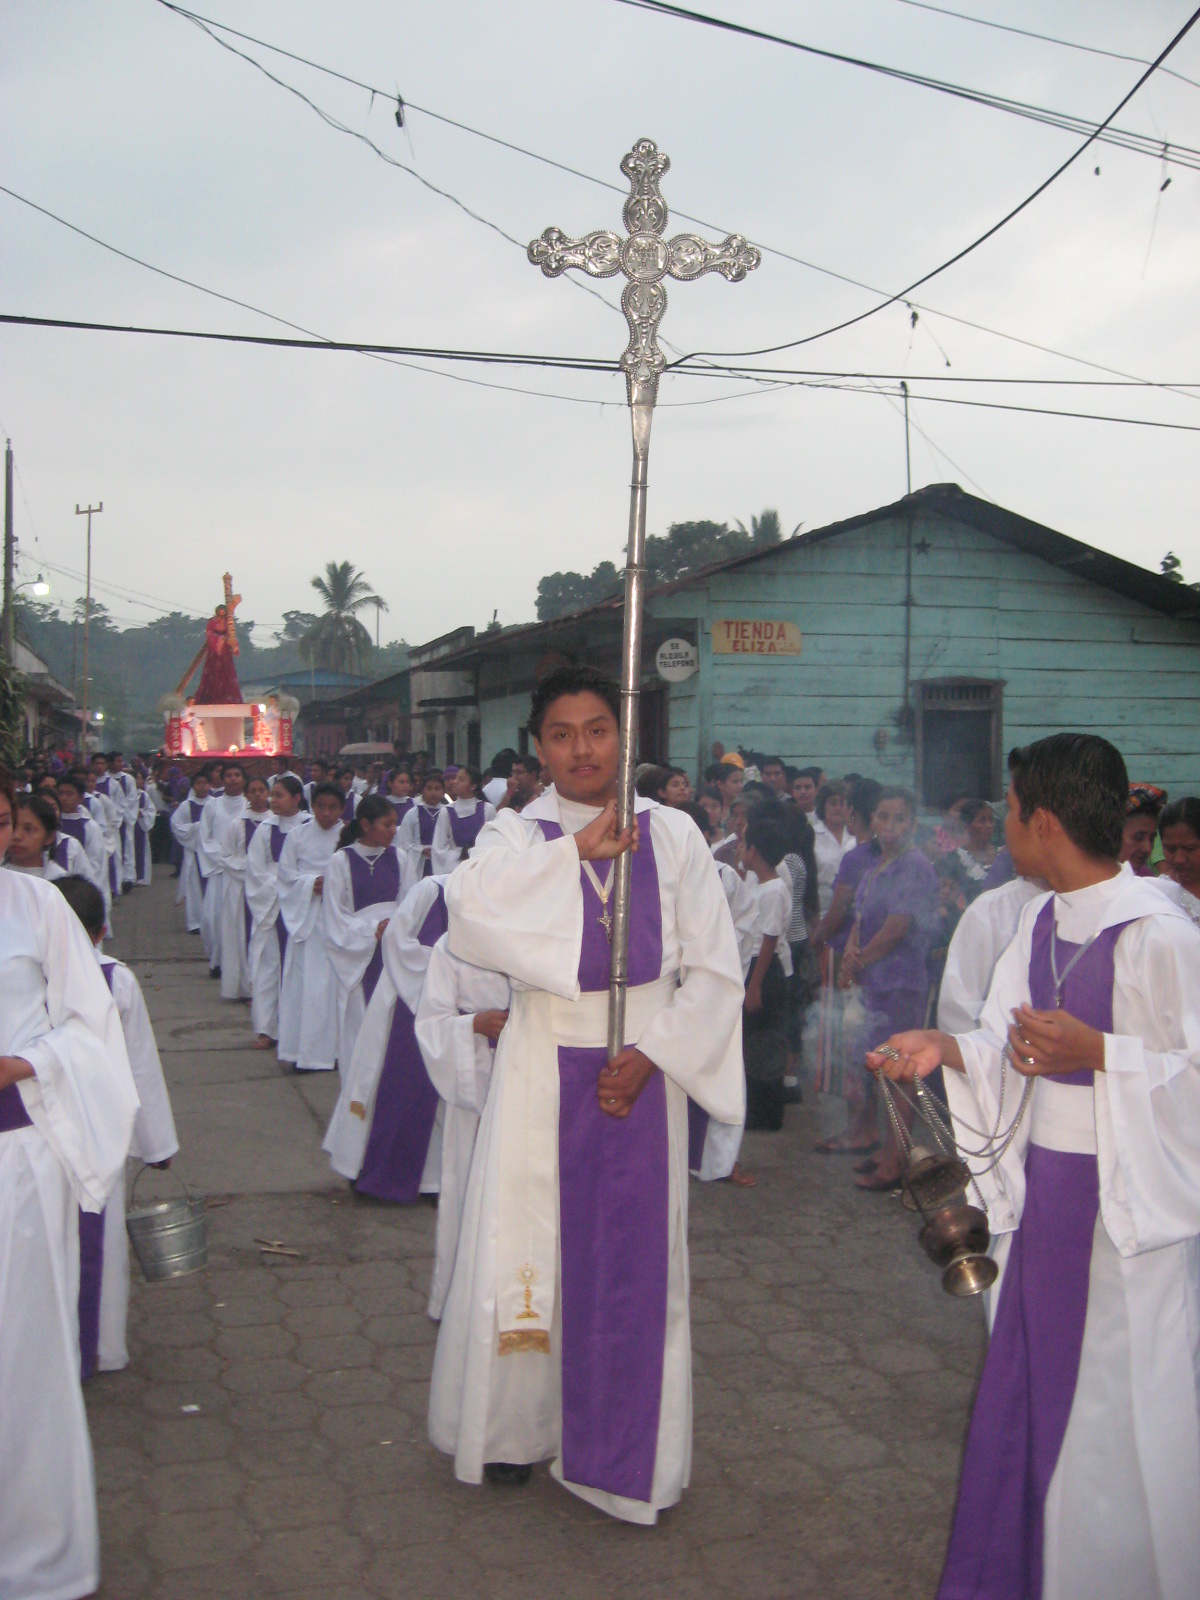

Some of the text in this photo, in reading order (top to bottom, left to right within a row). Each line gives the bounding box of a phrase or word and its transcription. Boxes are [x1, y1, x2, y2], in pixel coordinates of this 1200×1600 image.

[724, 621, 786, 640] TIENDA
[732, 641, 777, 653] ELIZA
[659, 660, 695, 668] TELEFONO
